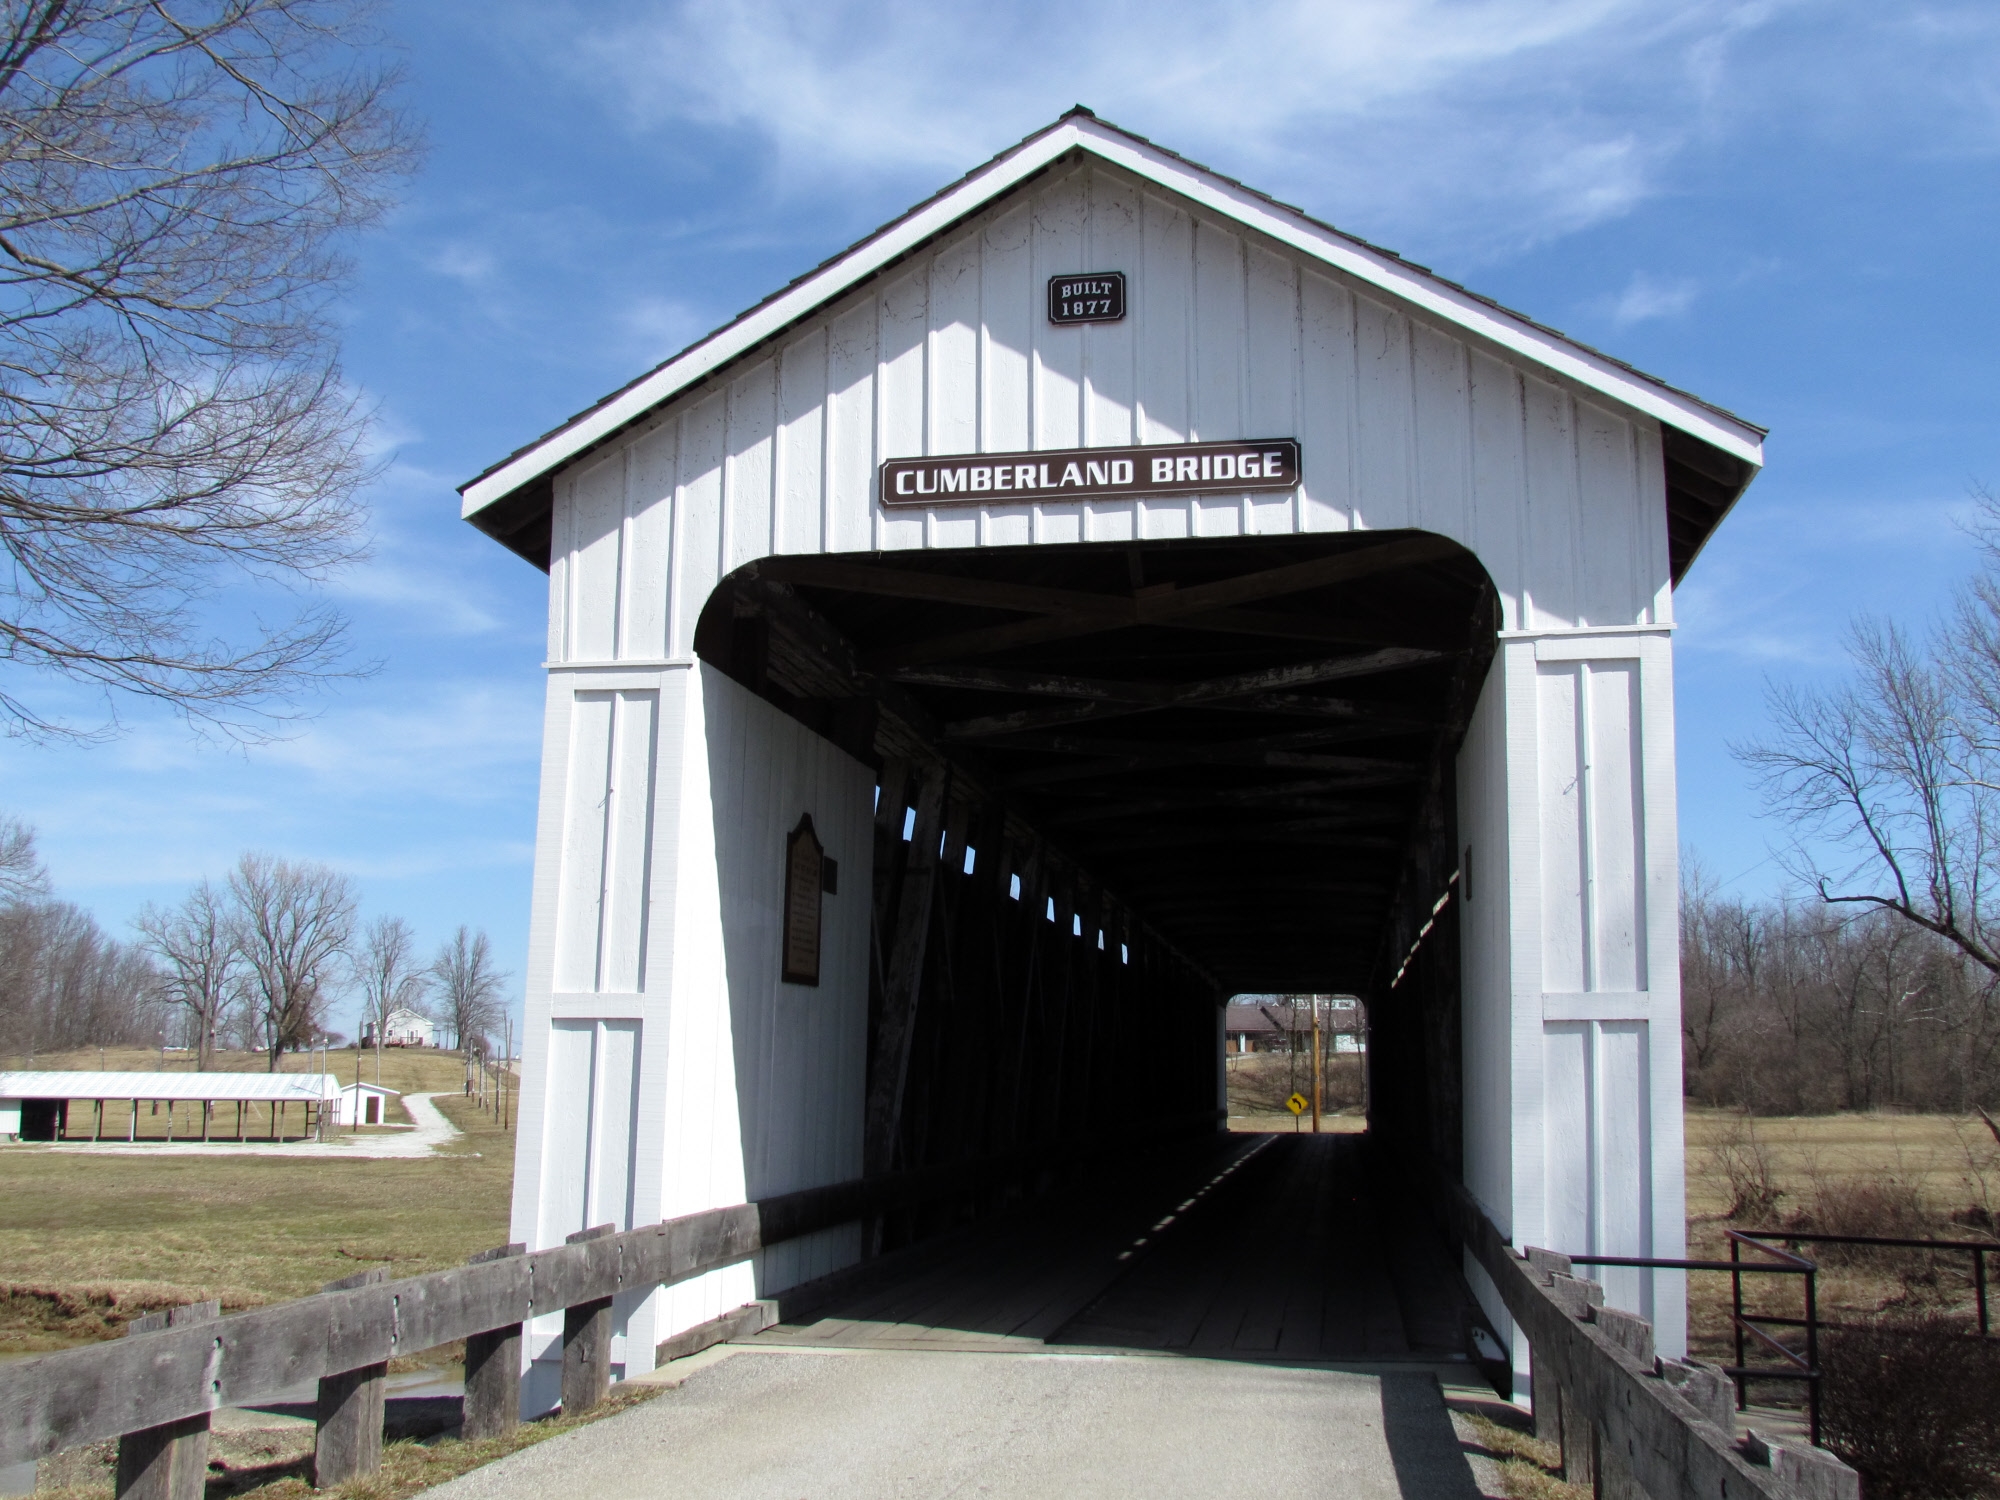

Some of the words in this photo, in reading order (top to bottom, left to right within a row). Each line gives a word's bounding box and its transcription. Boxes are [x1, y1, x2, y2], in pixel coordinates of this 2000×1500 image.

[1061, 282, 1112, 298] BUILT
[1062, 299, 1111, 316] 1877
[896, 459, 1134, 495] CUMBERLAND
[1151, 452, 1282, 483] BRIDGE
